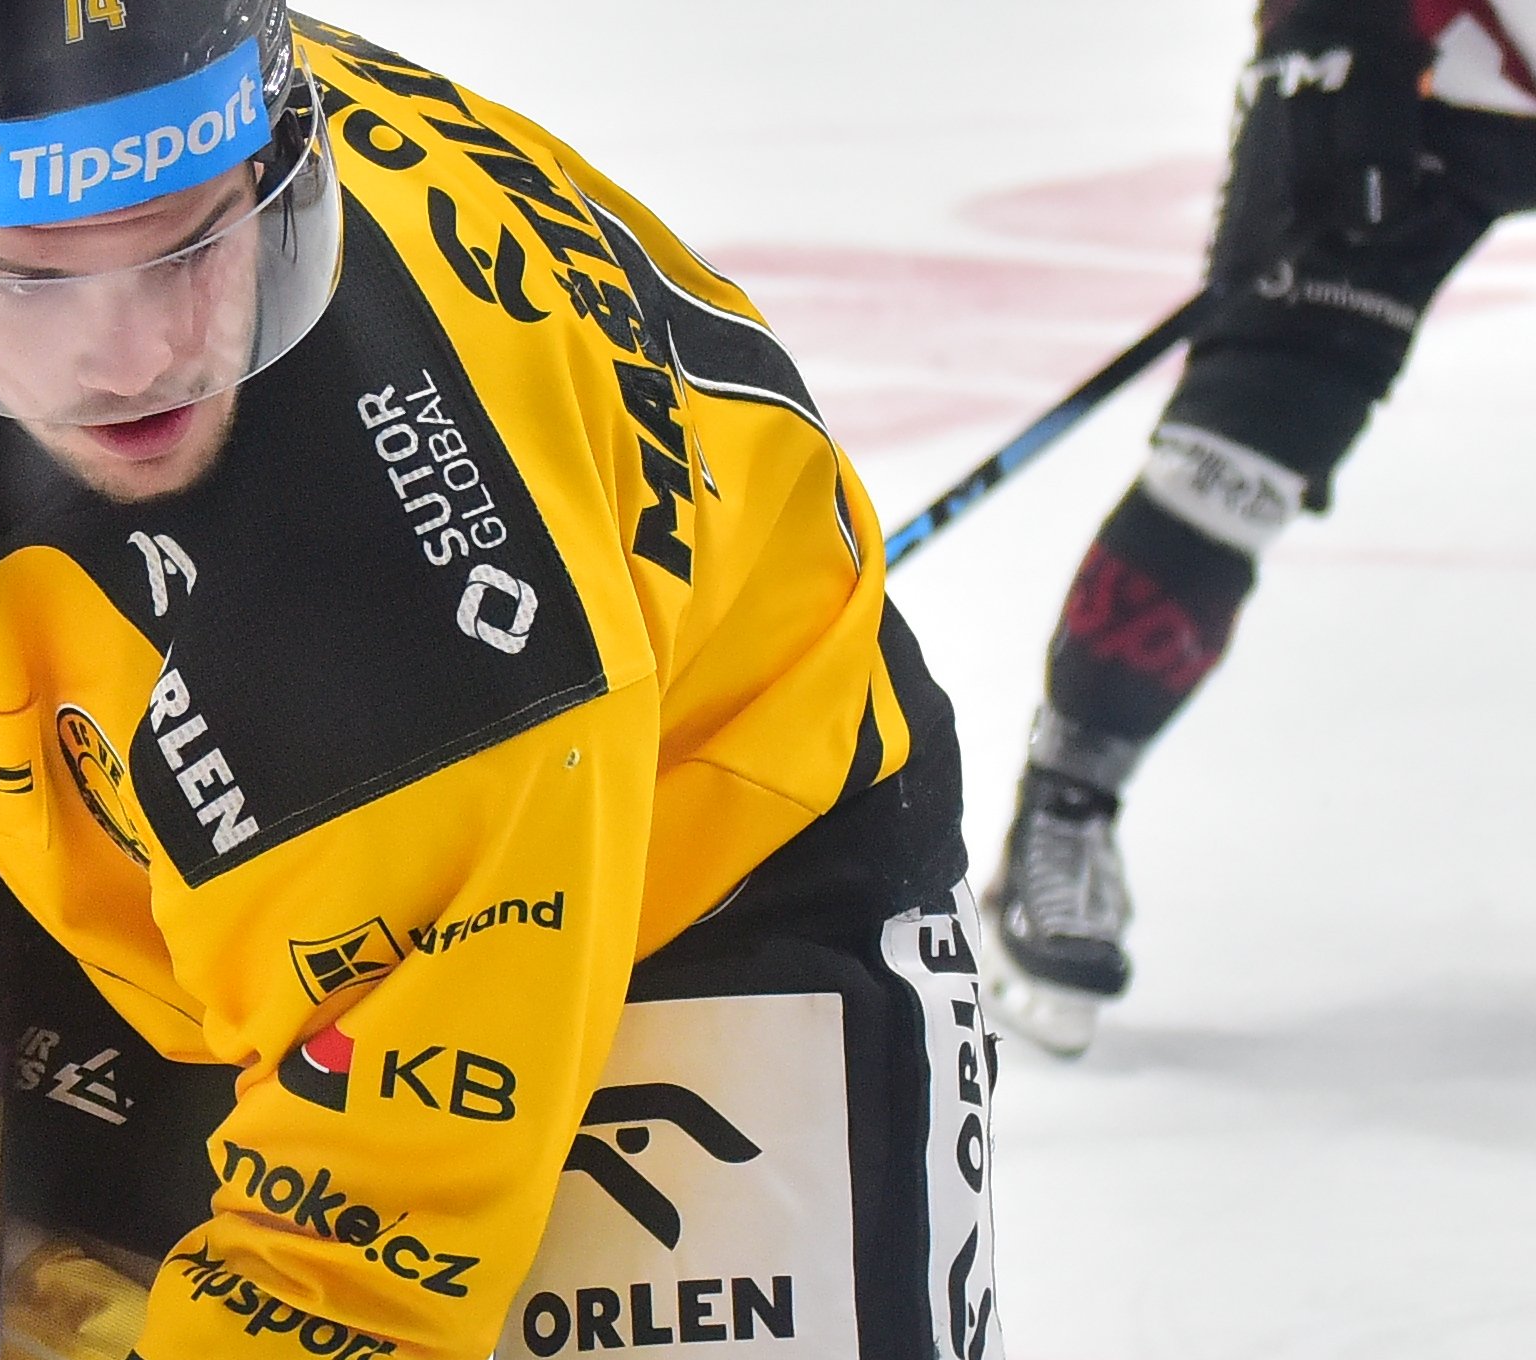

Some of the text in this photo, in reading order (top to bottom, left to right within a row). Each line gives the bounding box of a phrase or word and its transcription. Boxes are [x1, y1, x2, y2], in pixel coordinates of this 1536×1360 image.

[8, 72, 259, 203] Tipsport
[356, 383, 471, 567] SUTOR
[416, 367, 509, 550] GLOBAL
[148, 648, 261, 858] RLEN
[379, 1044, 518, 1122] KB
[521, 1274, 796, 1358] ORLEN
